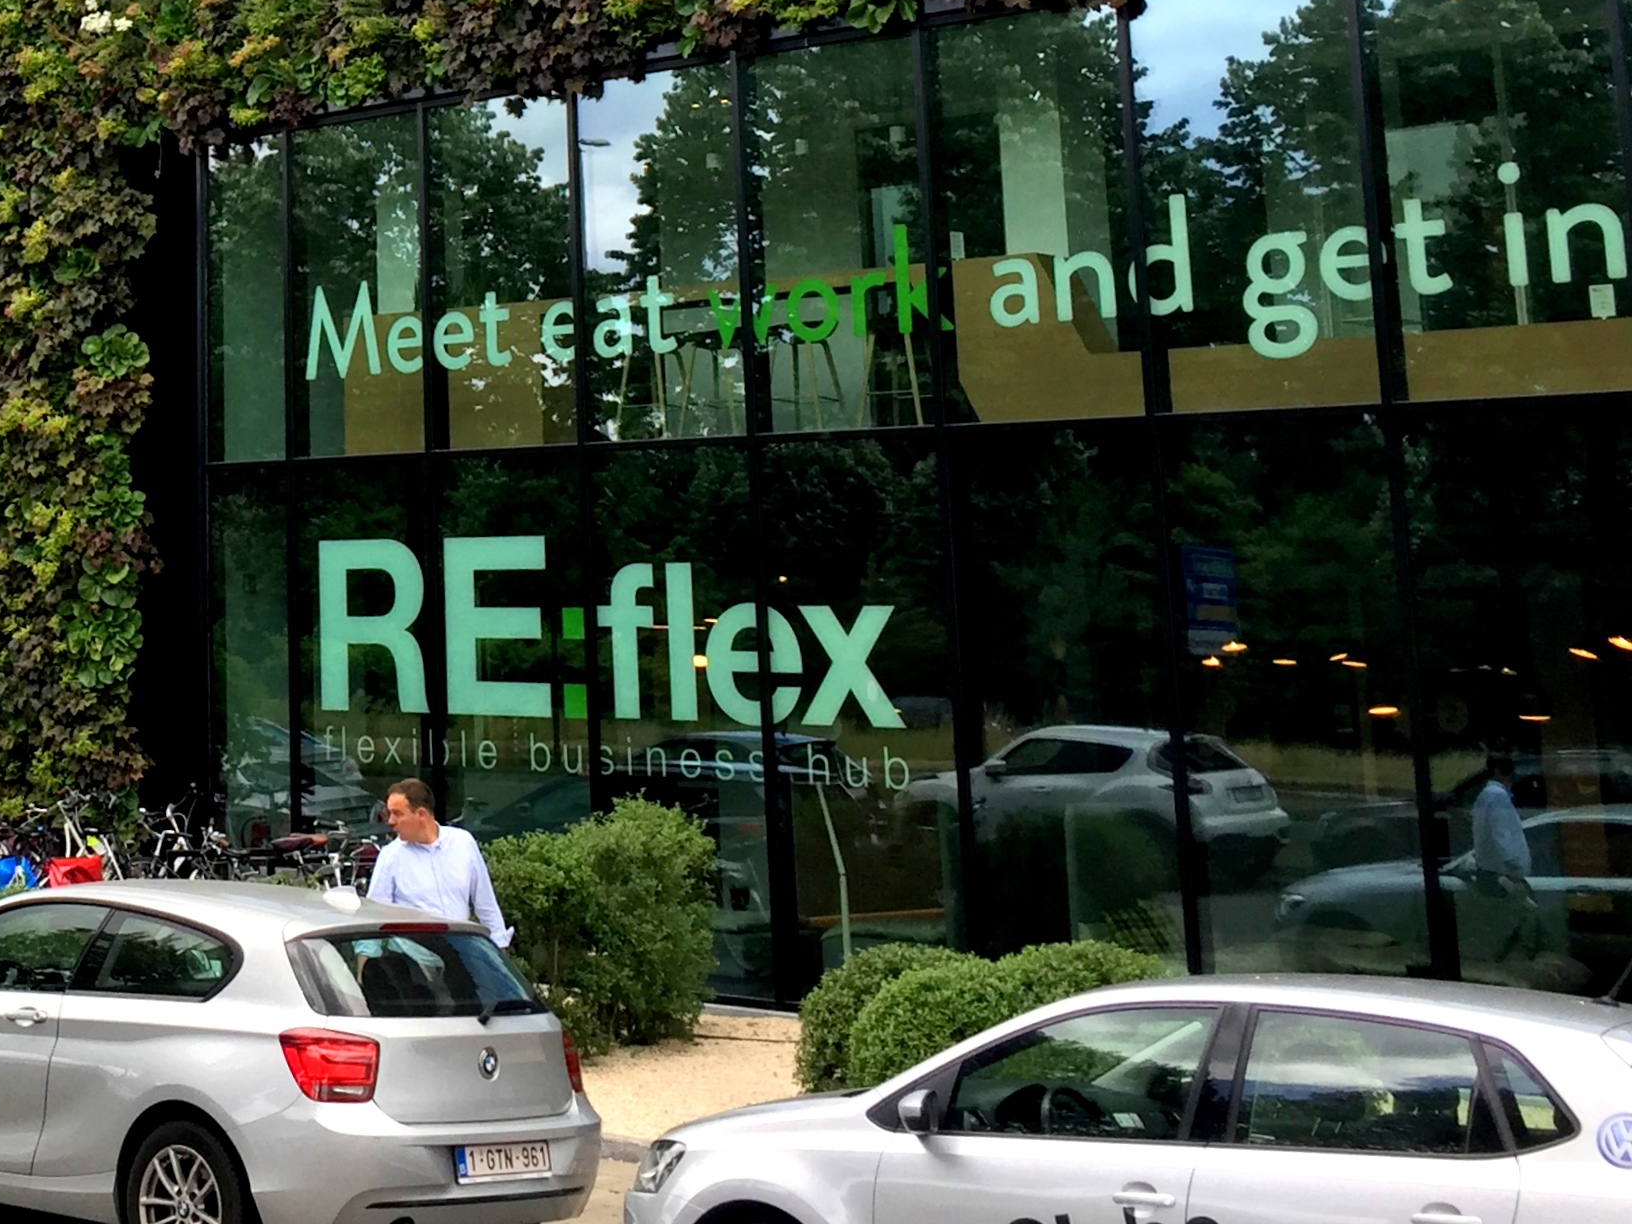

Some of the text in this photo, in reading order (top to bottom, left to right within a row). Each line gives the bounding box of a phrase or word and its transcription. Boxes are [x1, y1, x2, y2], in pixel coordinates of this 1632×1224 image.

[305, 161, 1629, 381] Meet eat work and get in
[318, 535, 908, 728] RE:flex
[323, 725, 910, 790] flexible business hub
